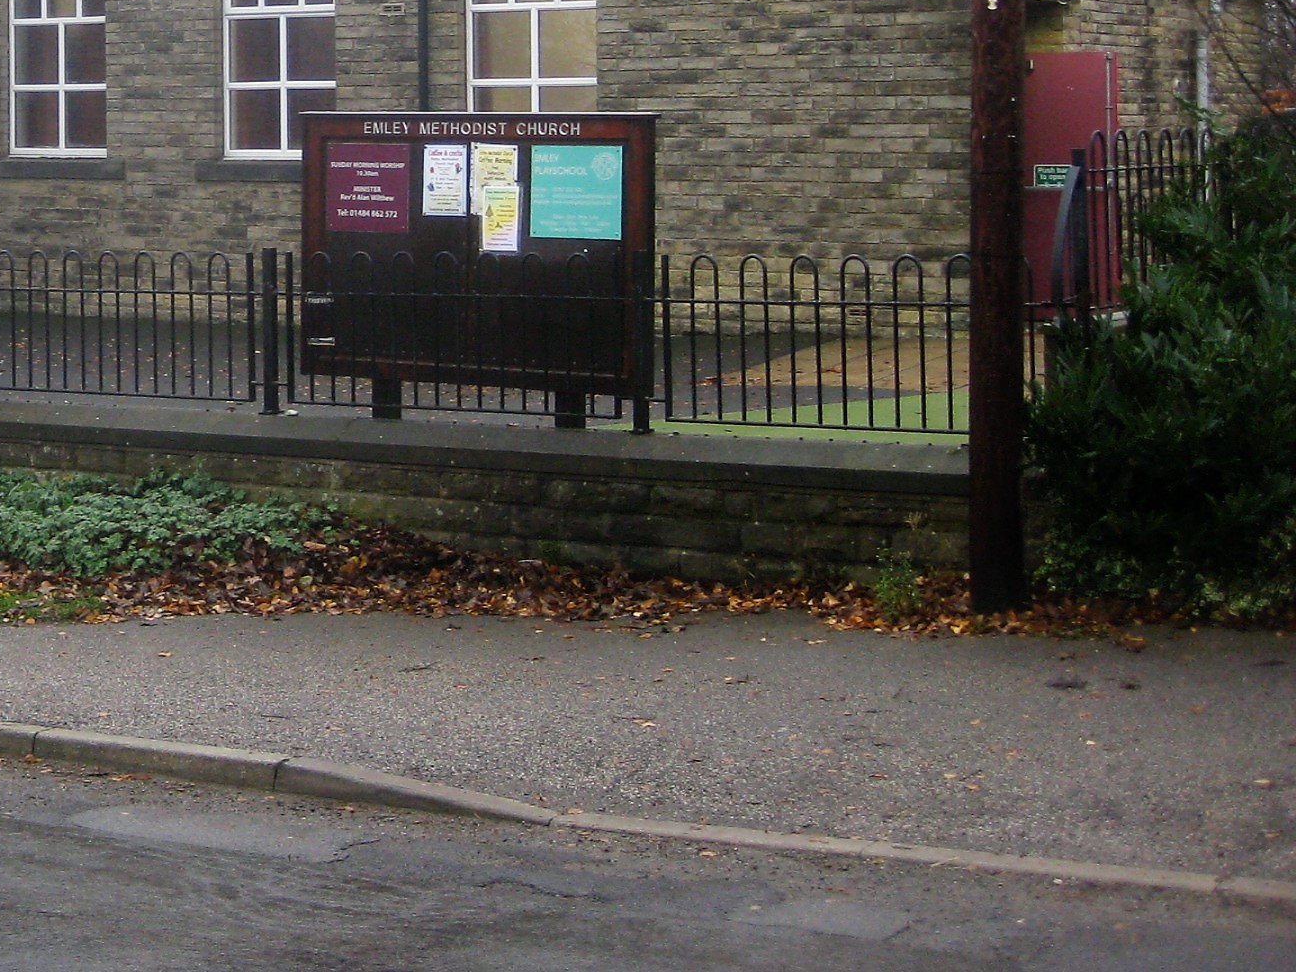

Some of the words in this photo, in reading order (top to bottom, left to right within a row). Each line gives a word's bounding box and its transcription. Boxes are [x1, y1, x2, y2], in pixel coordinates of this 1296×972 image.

[363, 121, 410, 135] EMLEY
[419, 122, 507, 136] METHODIST
[516, 122, 581, 136] CHURCH
[534, 154, 559, 162] EMLEY
[353, 161, 380, 169] MORNING
[534, 166, 588, 175] PLAYSCHOOL
[337, 208, 349, 216] Tel:
[349, 209, 371, 217] 01484
[385, 210, 398, 218] 572
